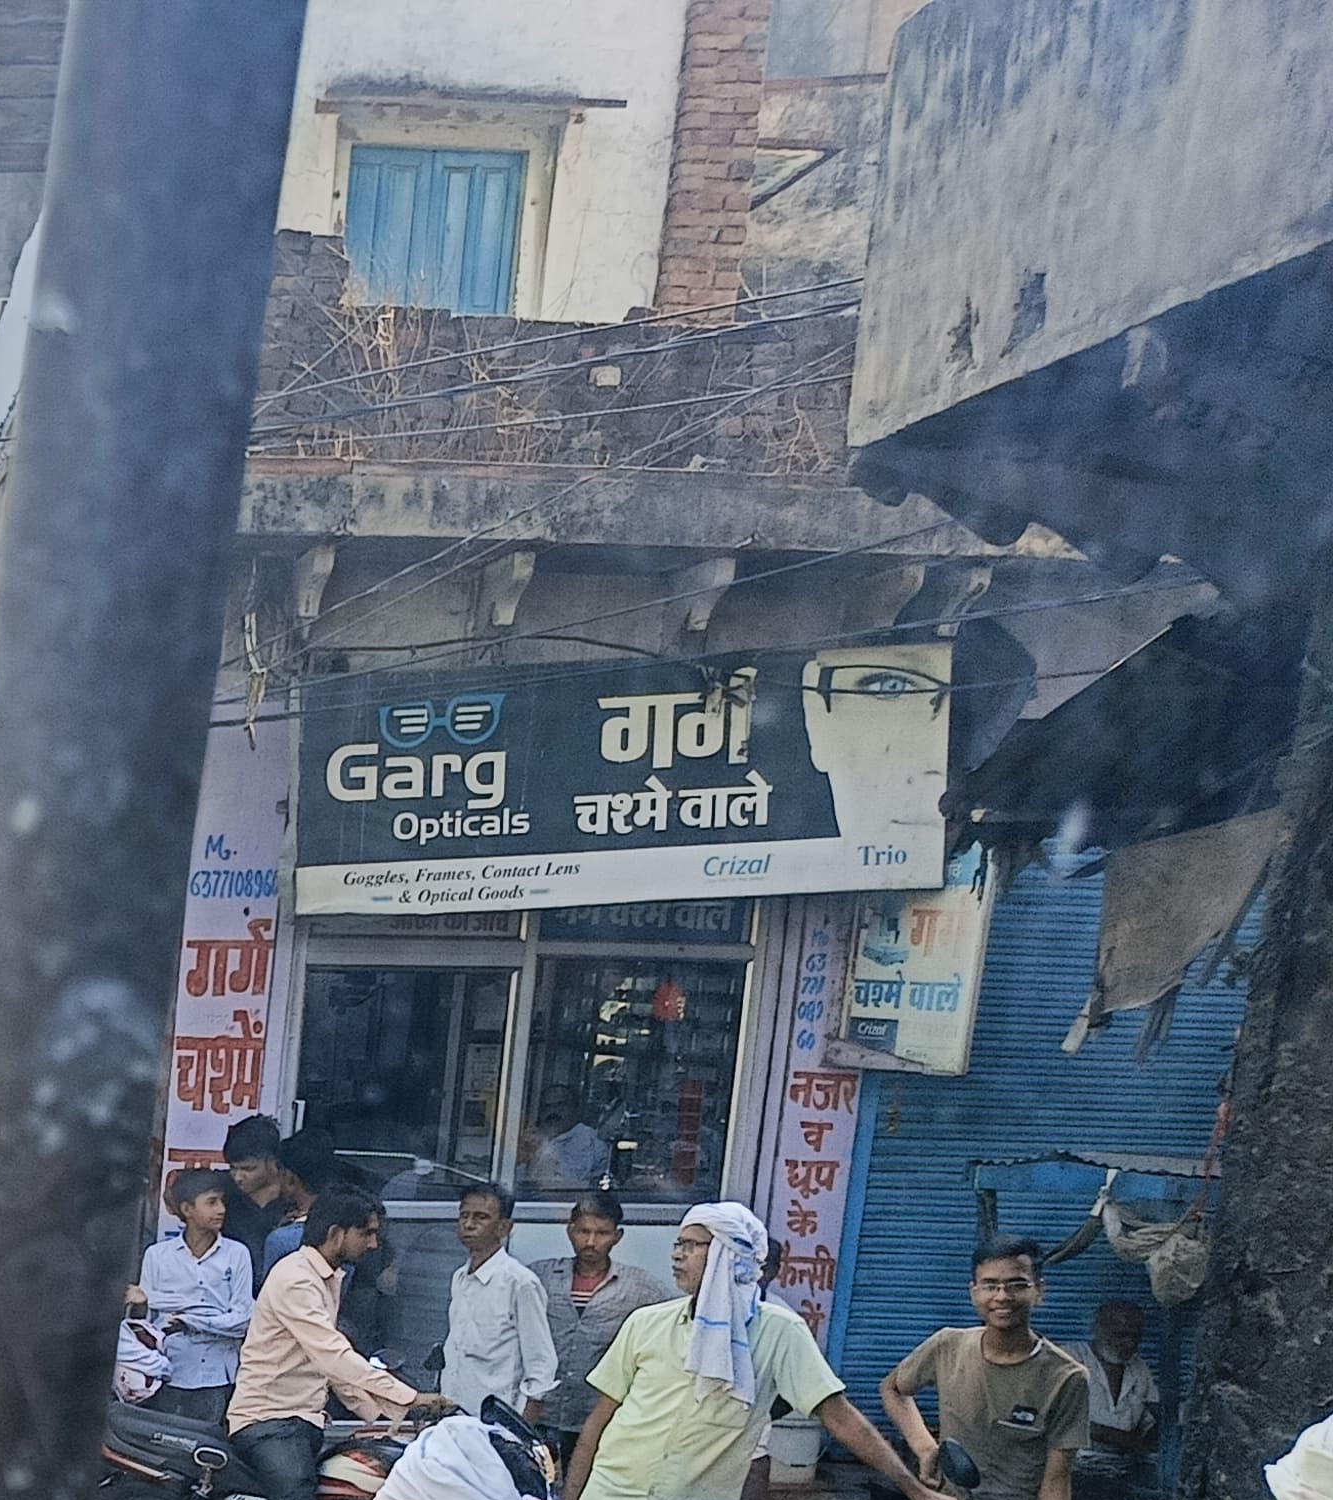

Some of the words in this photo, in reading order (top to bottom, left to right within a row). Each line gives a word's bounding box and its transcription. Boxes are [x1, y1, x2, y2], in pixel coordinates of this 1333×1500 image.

[597, 666, 757, 769] गर्ग
[326, 742, 506, 810] Garg
[573, 776, 673, 835] चश्मे
[678, 770, 773, 830] वाले
[392, 808, 530, 844] Opticals
[343, 869, 410, 887] Goggles,
[414, 866, 476, 883] Frames,
[481, 863, 541, 880] Contact
[544, 861, 582, 876] Lens
[703, 853, 772, 877] Crizal
[858, 845, 907, 868] Trio
[398, 890, 412, 903] &
[417, 886, 474, 906] Optical
[478, 883, 525, 900] Goods
[186, 918, 275, 997] गर्ग
[853, 970, 906, 1010] चश्मे
[789, 1071, 859, 1114] नजर
[786, 1200, 818, 1238] के
